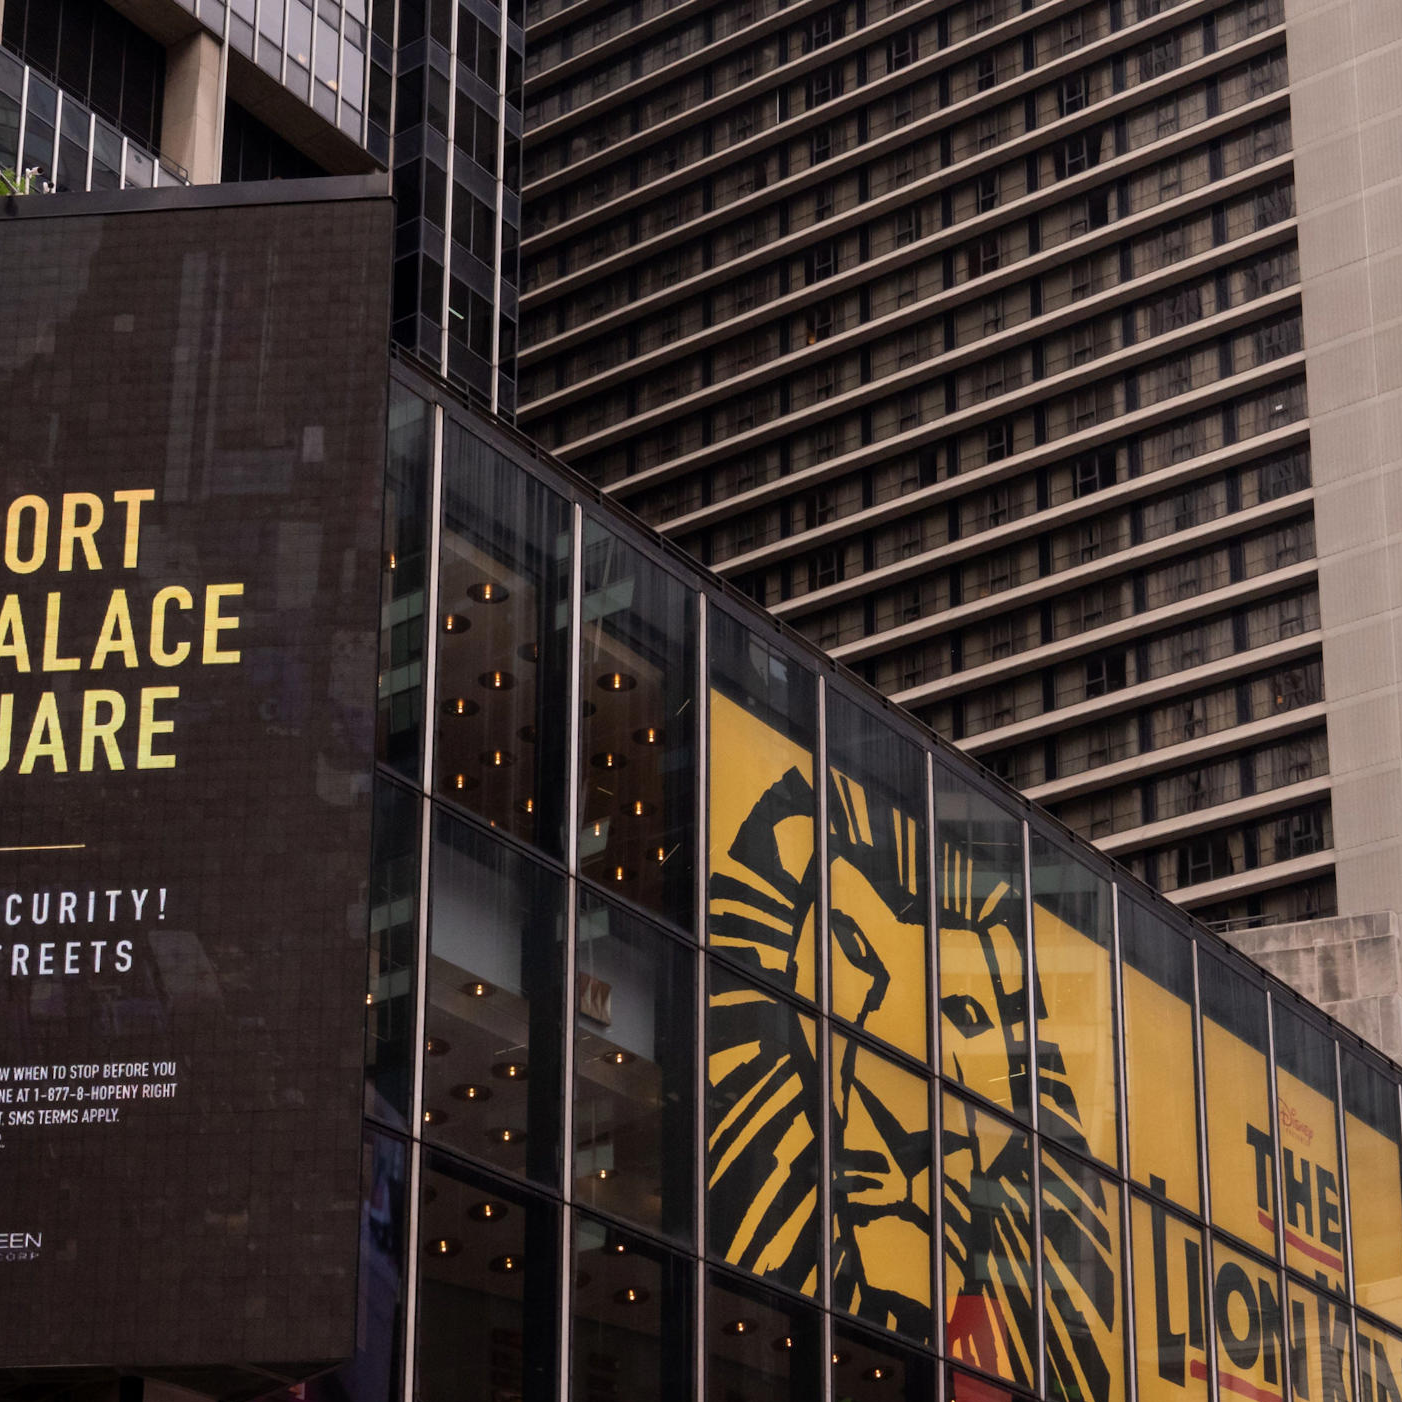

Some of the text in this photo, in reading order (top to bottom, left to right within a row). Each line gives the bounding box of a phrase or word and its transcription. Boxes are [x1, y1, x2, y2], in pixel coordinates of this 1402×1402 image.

[13, 1065, 49, 1081] WHEN
[52, 1065, 67, 1080] TO
[69, 1064, 100, 1079] STOP
[102, 1062, 150, 1078] BEFORE
[152, 1061, 176, 1076] YOU
[1246, 1123, 1343, 1252] THE
[1149, 1173, 1311, 1402] LION
